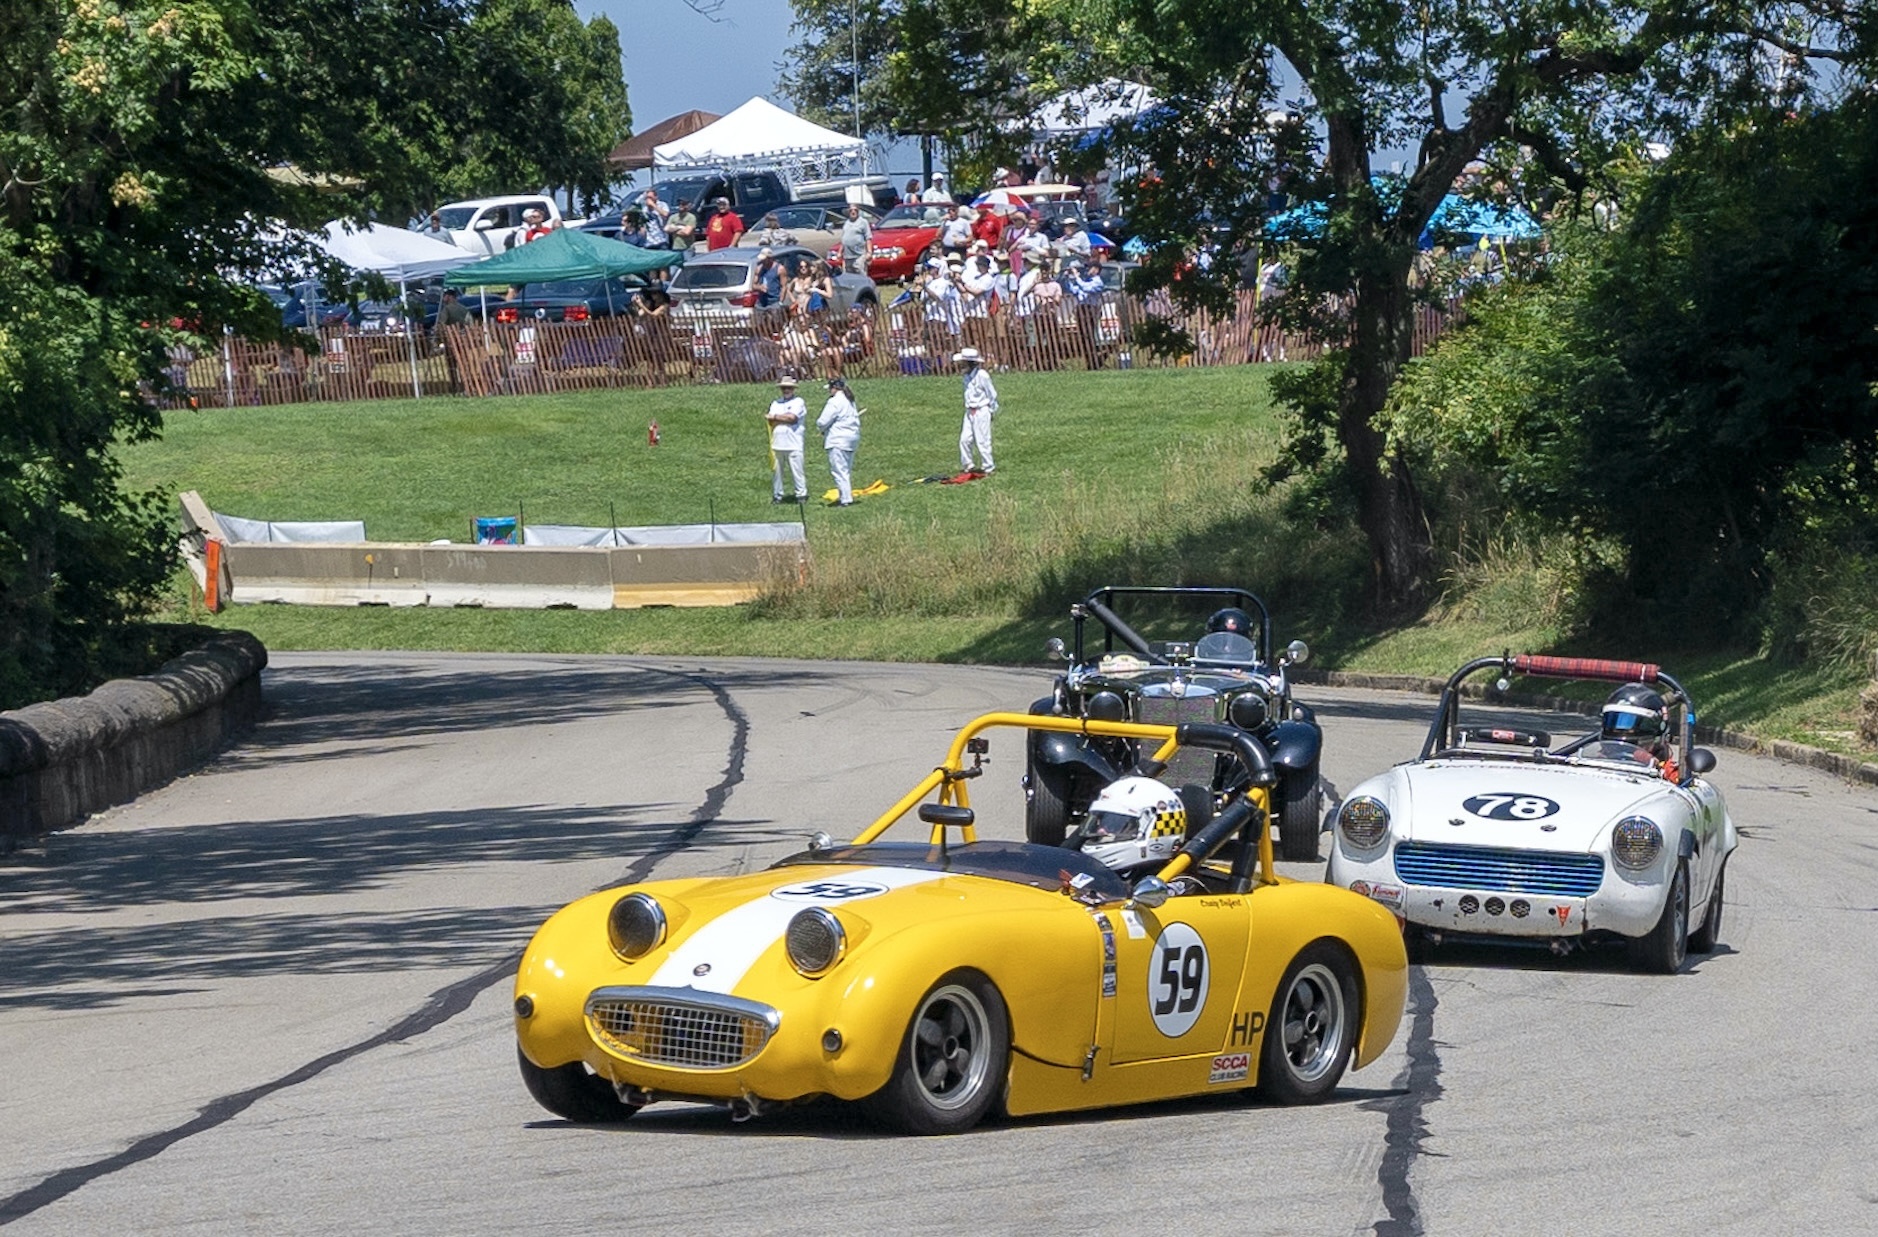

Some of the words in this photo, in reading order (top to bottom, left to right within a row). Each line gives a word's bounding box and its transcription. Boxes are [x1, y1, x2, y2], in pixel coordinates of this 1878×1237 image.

[1476, 795, 1549, 819] 78
[776, 882, 882, 899] 59
[1155, 944, 1204, 1015] 59
[1230, 1011, 1265, 1047] HP
[1213, 1055, 1248, 1071] SCCA
